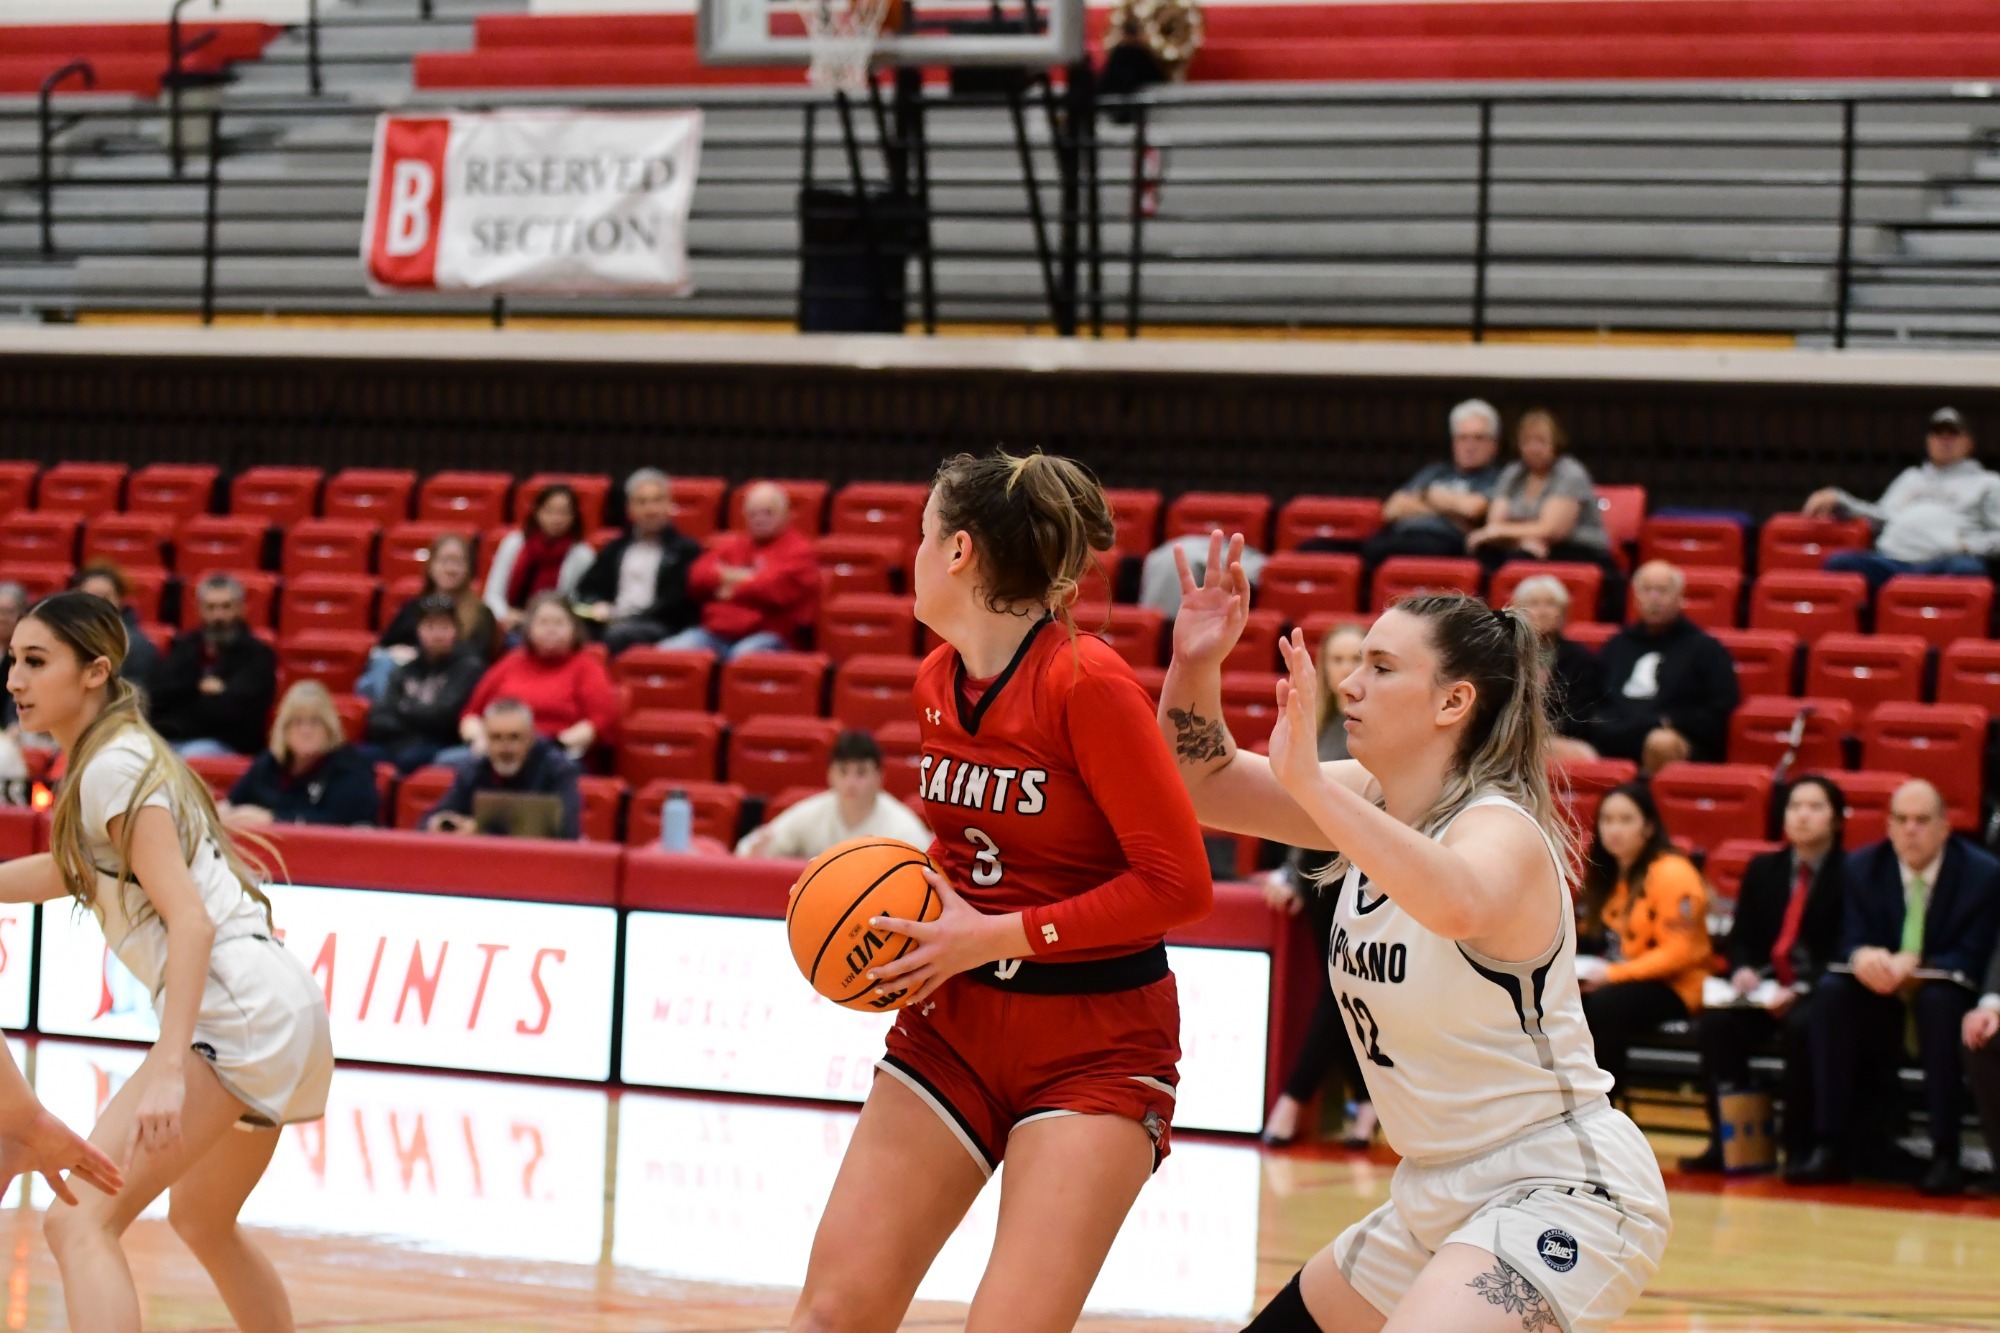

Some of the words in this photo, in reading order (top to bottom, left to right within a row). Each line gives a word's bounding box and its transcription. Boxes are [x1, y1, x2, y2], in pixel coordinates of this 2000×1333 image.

[464, 152, 676, 198] RESERVED
[386, 158, 434, 257] B
[471, 212, 663, 256] SECTION
[919, 753, 1048, 816] SAINTS
[963, 826, 1005, 887] 3
[272, 928, 567, 1036] AINTS
[1341, 991, 1395, 1068] 12
[1541, 1240, 1576, 1260] Blues
